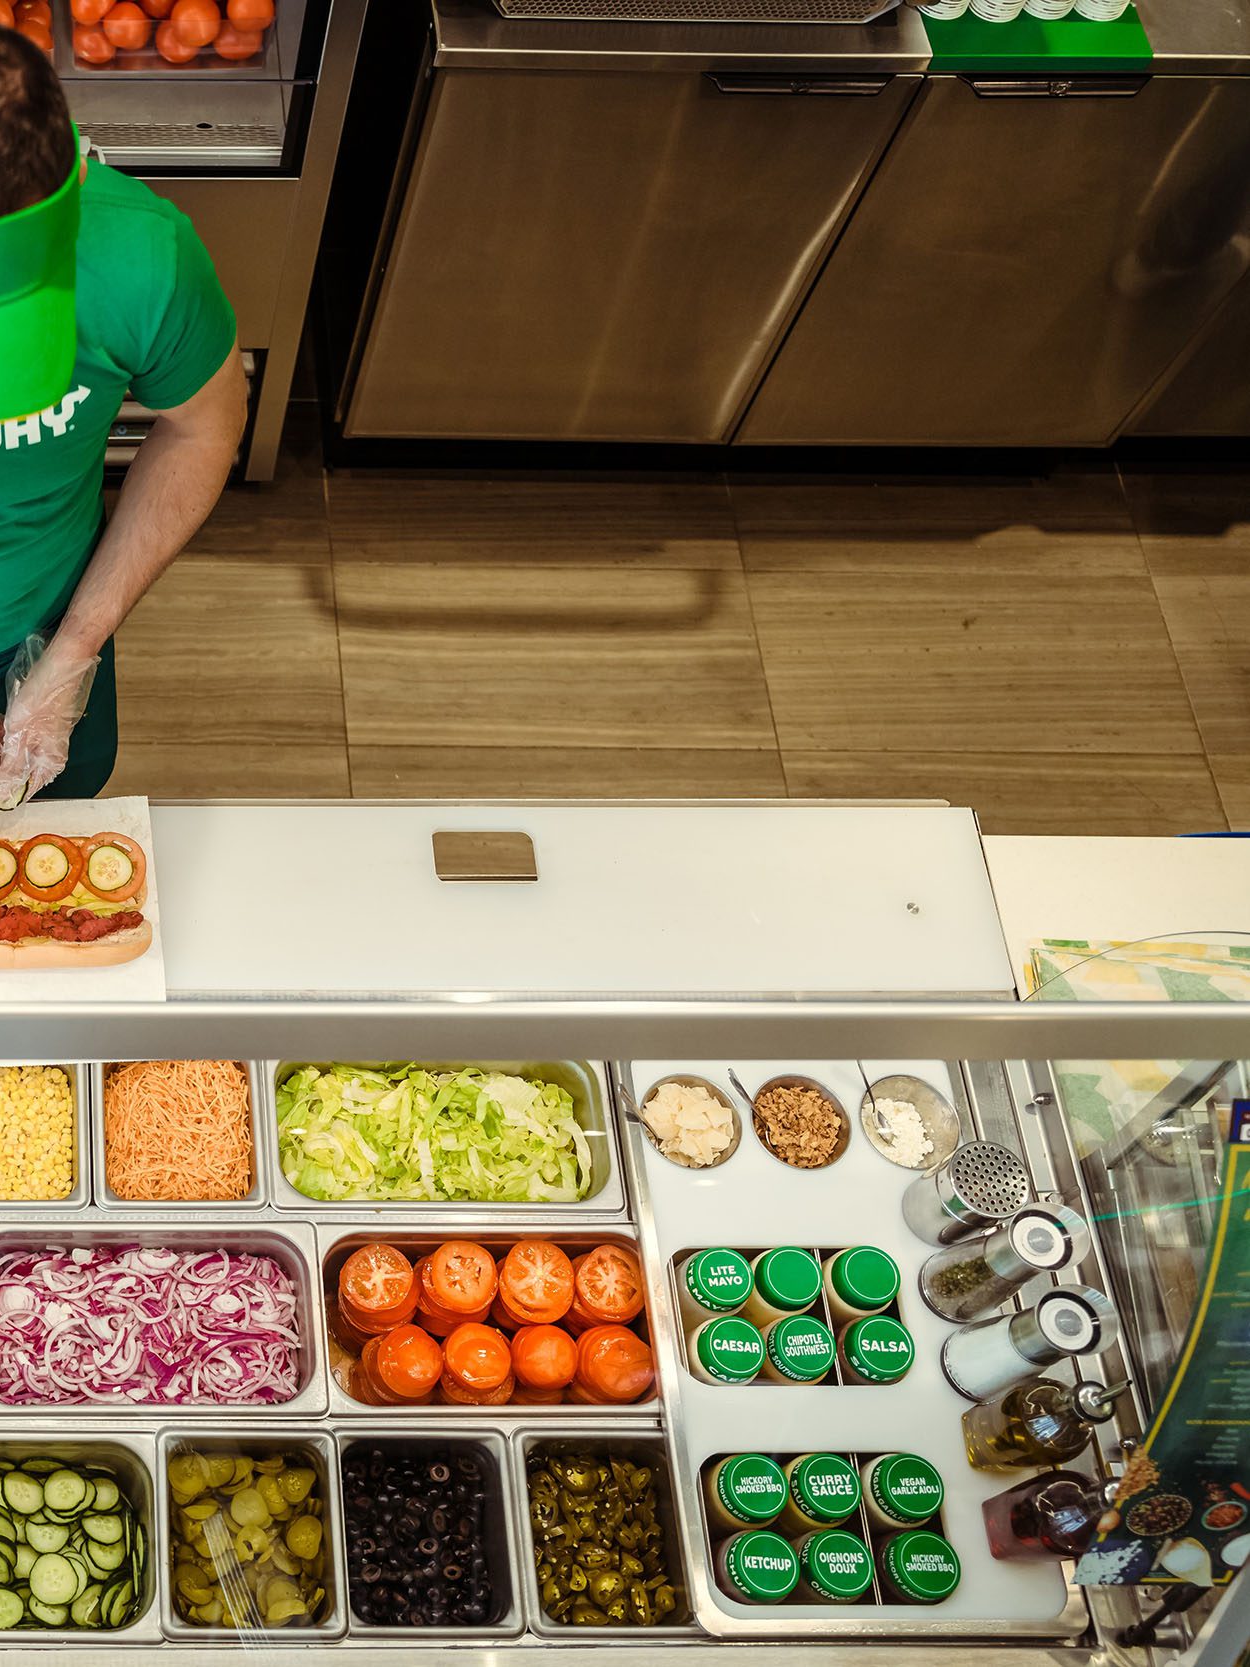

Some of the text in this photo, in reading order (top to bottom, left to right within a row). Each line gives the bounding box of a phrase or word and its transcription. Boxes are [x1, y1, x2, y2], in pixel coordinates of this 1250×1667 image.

[710, 1265, 737, 1276] LITE
[708, 1276, 743, 1287] MAYO
[786, 1333, 823, 1346] CHIPOTLE
[713, 1338, 760, 1353] CAESAR
[784, 1343, 830, 1357] SOUTHWEST
[861, 1339, 909, 1353] SALSA
[740, 1476, 773, 1485] HICKORY
[808, 1474, 851, 1486] CURRY
[899, 1477, 926, 1486] VEGAN
[735, 1484, 783, 1494] SMOKED BBQ
[811, 1485, 854, 1496] SAUCE
[891, 1485, 940, 1495] GARLIC AIOLI
[791, 1479, 816, 1516] SAUCE
[744, 1555, 792, 1571] KETCHUP
[819, 1552, 864, 1563] OIGNONS
[910, 1554, 944, 1563] HICKORY
[829, 1563, 857, 1574] DOUX
[905, 1562, 955, 1574] SMOKED BBQ
